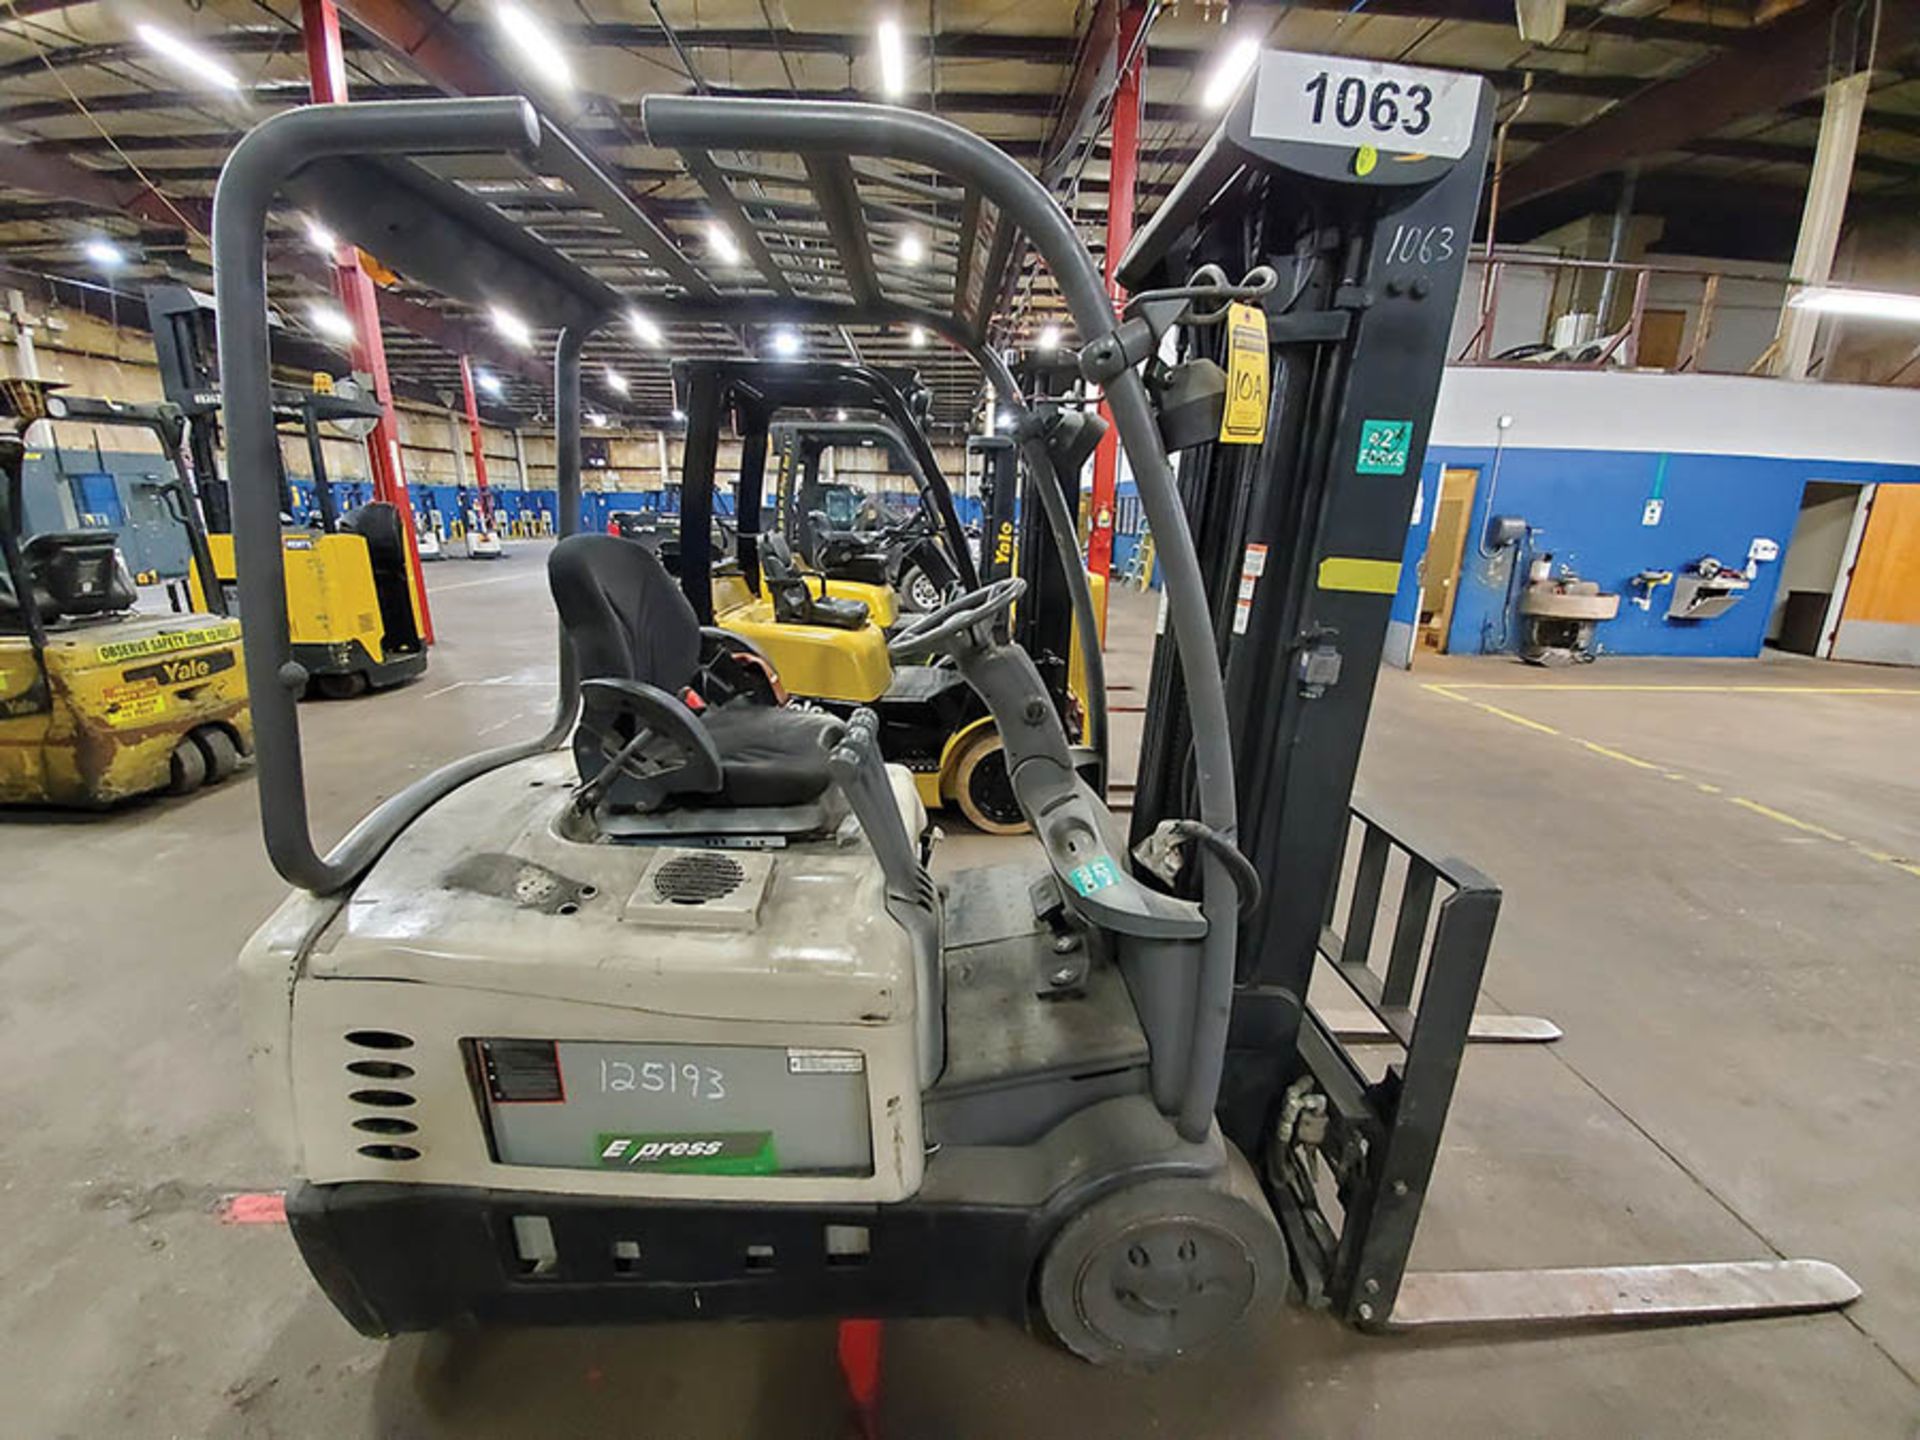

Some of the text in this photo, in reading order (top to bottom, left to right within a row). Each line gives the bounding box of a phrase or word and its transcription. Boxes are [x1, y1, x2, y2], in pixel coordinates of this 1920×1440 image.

[1305, 71, 1433, 135] 1063
[1386, 225, 1454, 264] 1063
[1234, 369, 1263, 403] 10A
[994, 521, 1012, 564] Yale
[100, 639, 150, 660] OBSERVE
[150, 634, 185, 652] SAFETY
[163, 659, 210, 684] Yale
[601, 1059, 726, 1099] 125193
